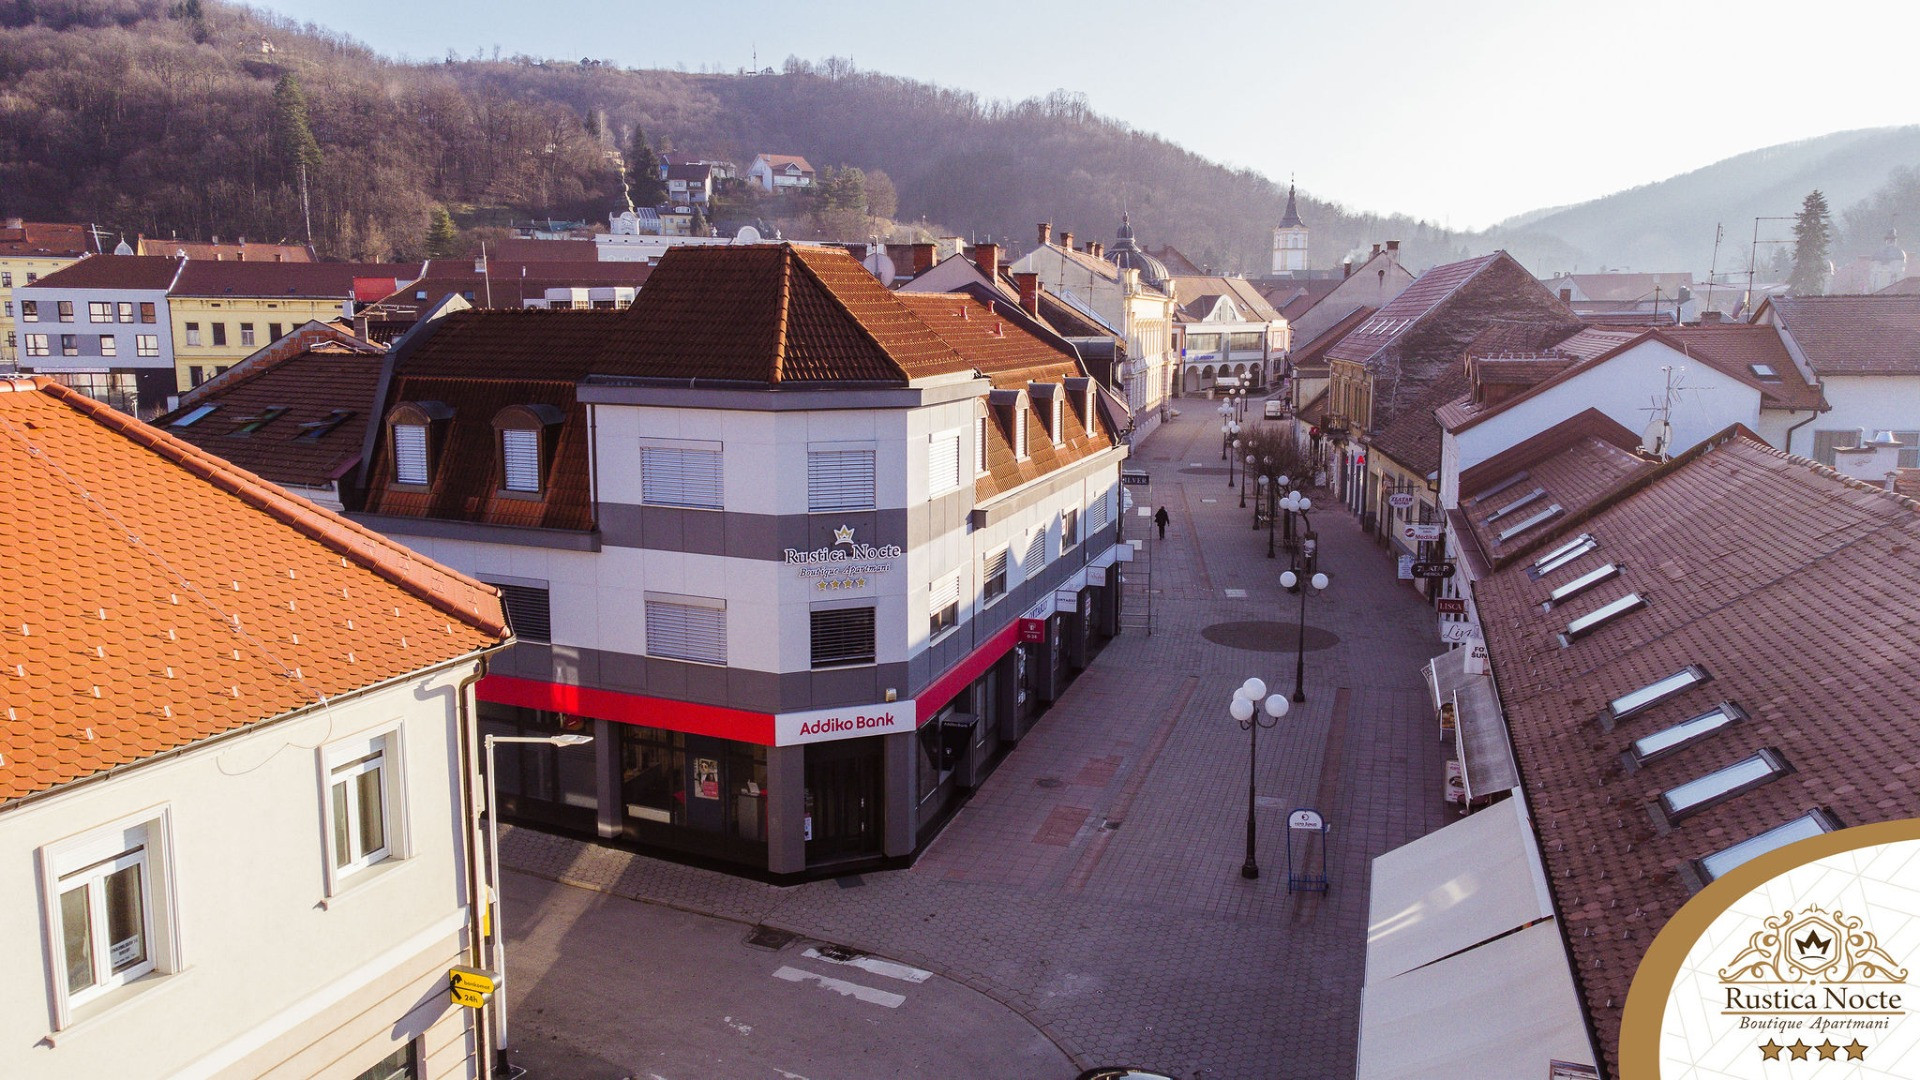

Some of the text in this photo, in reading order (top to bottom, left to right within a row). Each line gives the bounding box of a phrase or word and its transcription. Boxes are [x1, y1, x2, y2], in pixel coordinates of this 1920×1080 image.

[784, 543, 901, 565] Rustica Nocte
[800, 562, 891, 578] Boutique Apartmani
[1440, 602, 1463, 610] LISCA
[1470, 651, 1488, 659] ŠUN
[800, 712, 895, 736] Addiko Bank
[464, 994, 478, 1003] 24h
